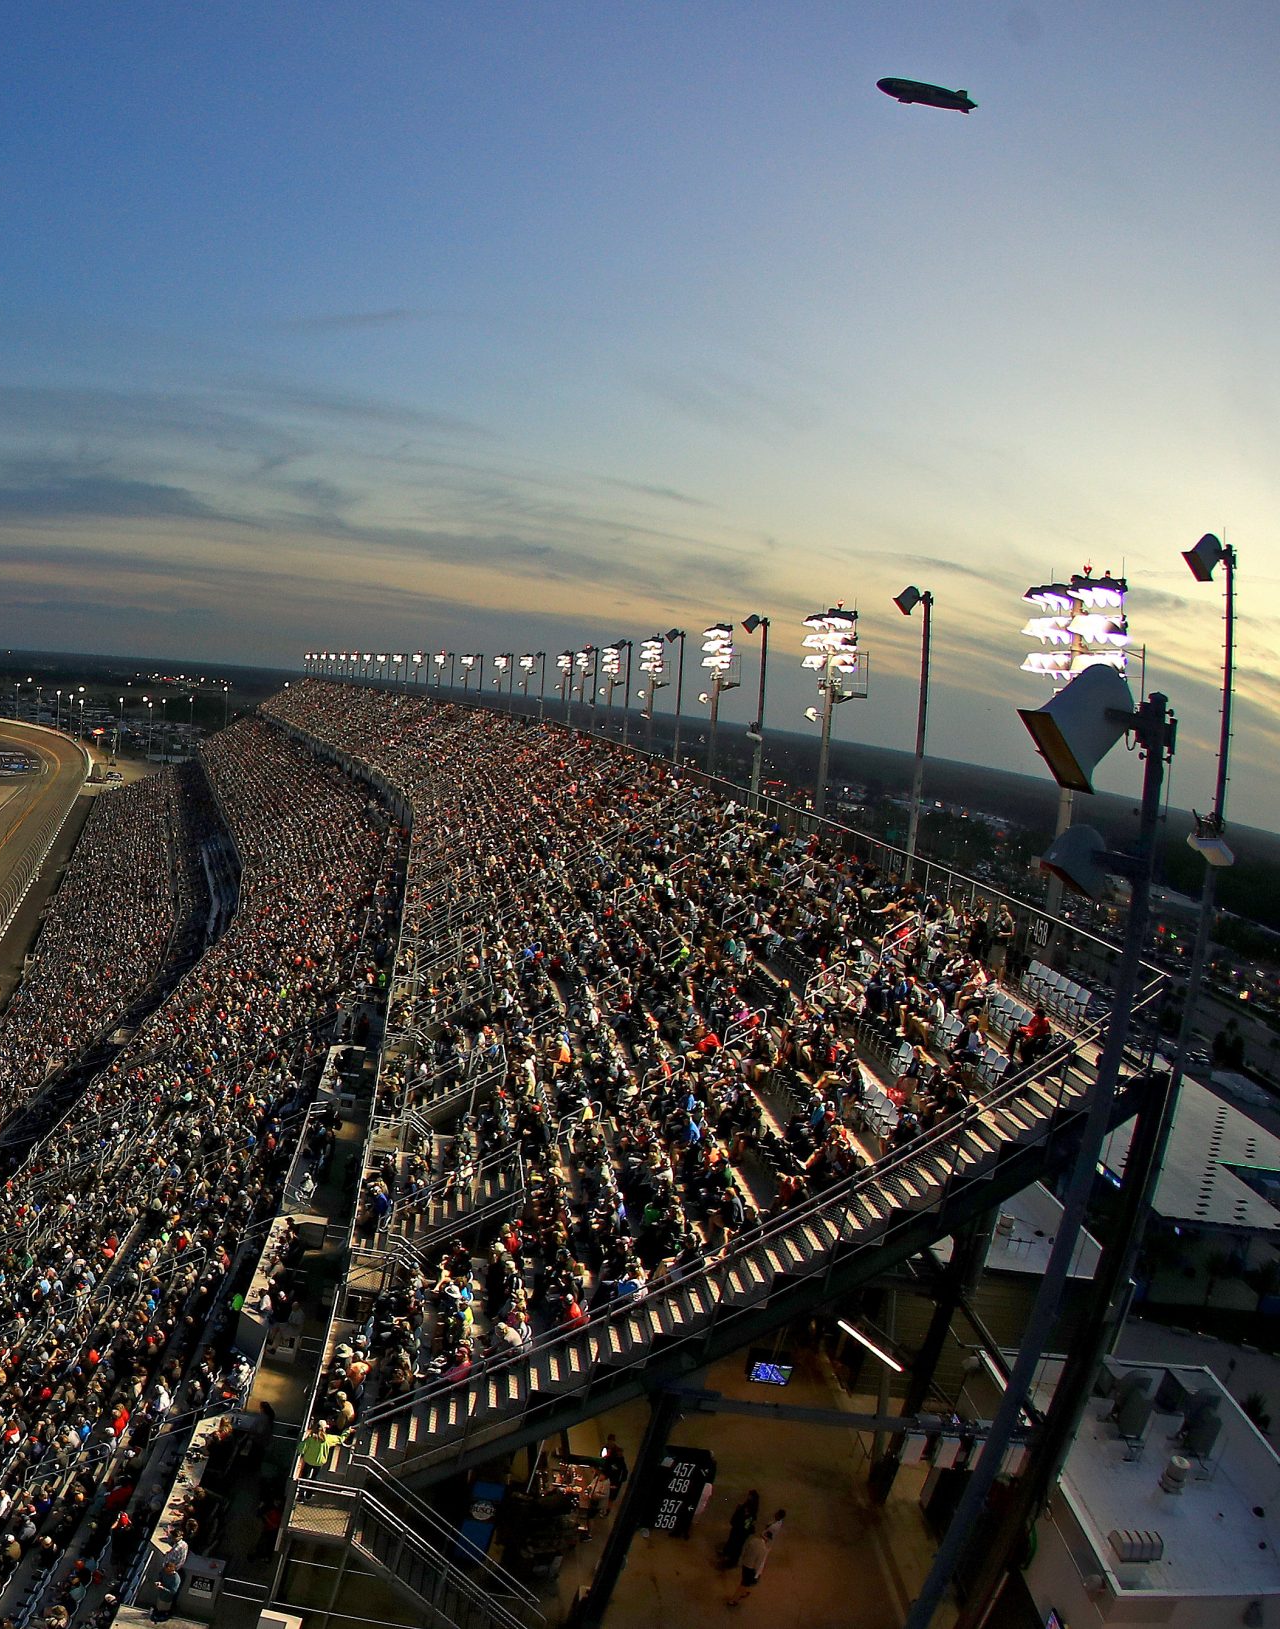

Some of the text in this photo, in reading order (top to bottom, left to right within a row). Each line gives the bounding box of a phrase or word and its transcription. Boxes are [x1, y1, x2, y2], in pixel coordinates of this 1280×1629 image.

[1033, 918, 1049, 947] 458
[673, 1462, 696, 1478] 457
[667, 1478, 690, 1493] 458
[660, 1499, 683, 1514] 357
[654, 1514, 677, 1529] 358
